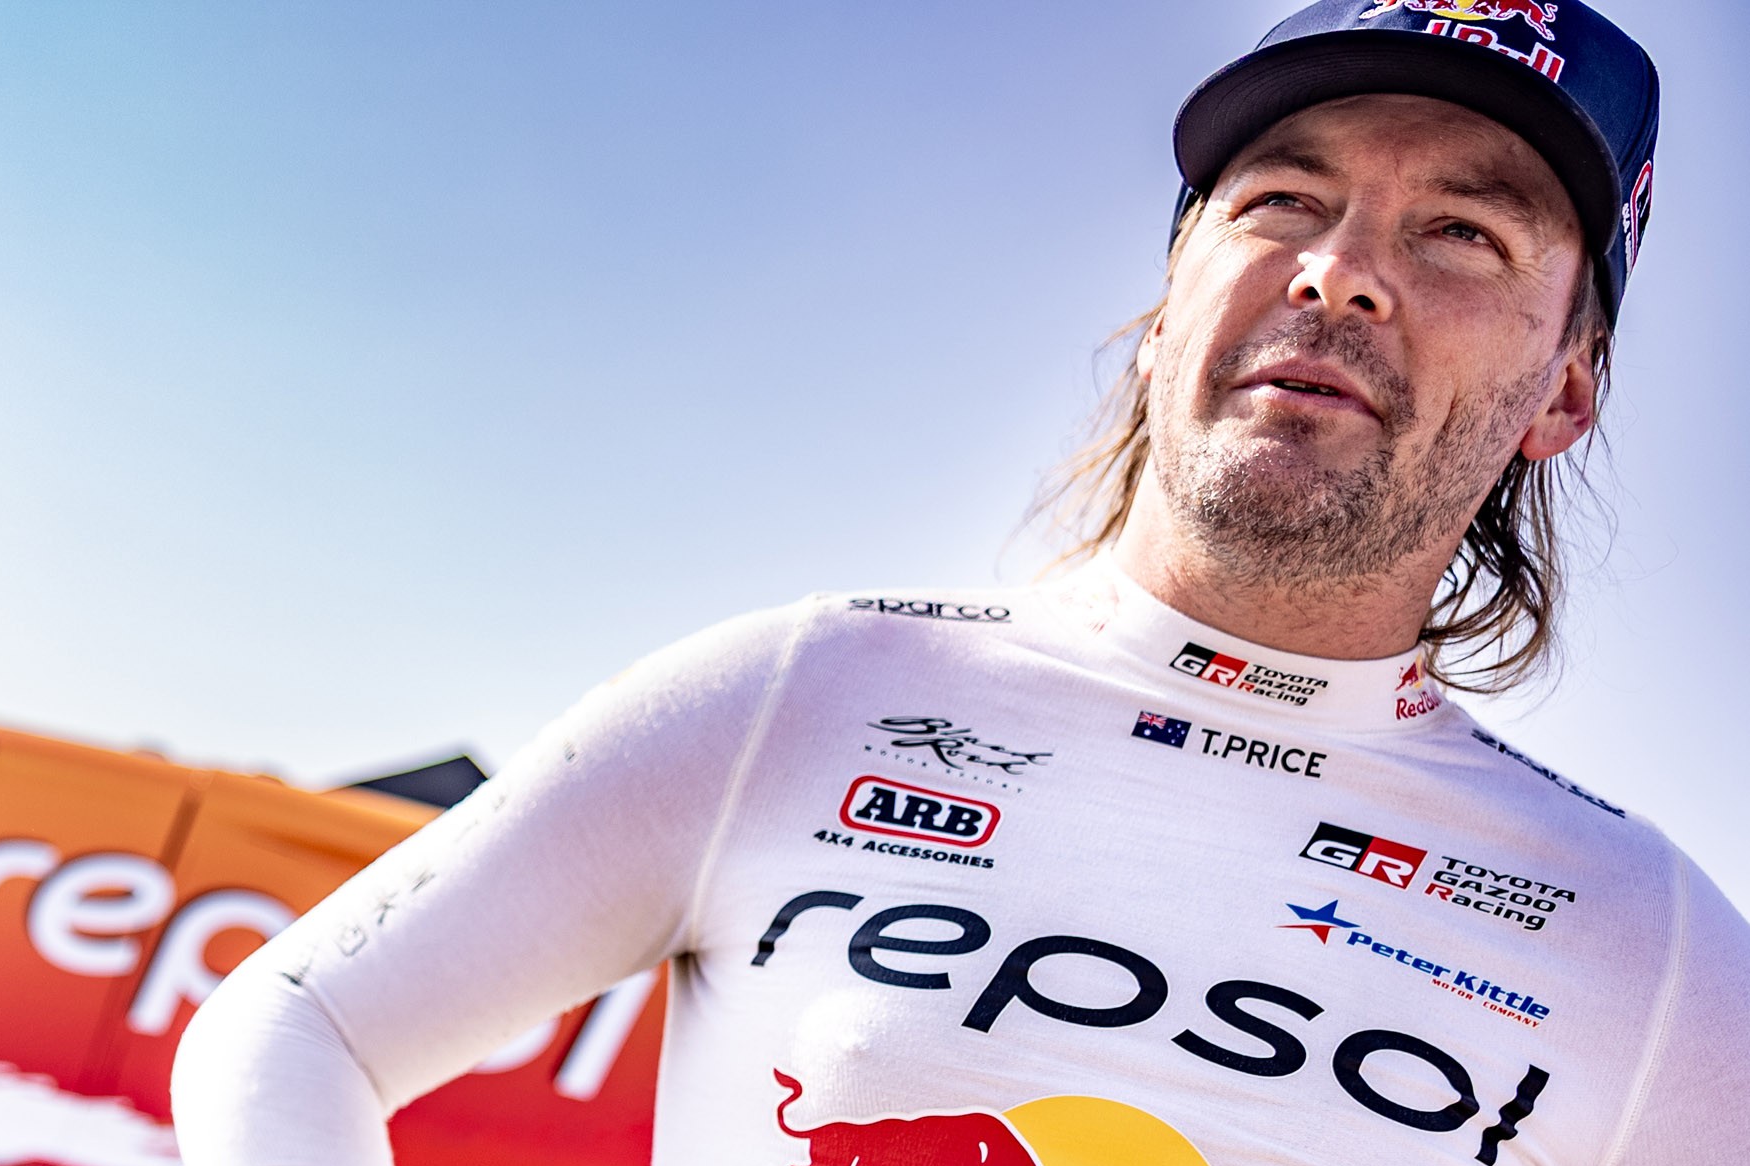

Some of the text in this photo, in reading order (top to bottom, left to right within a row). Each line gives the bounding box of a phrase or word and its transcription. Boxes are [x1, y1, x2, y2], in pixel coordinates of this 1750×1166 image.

[1172, 653, 1329, 689] GR TOYOTA
[1237, 682, 1308, 707] Racing
[1244, 674, 1316, 697] GAZOO
[1201, 728, 1328, 778] T.PRICE
[855, 786, 983, 838] ARB
[862, 840, 995, 869] ACCESSORIES
[1306, 839, 1576, 904] GR TOYOTA
[1424, 882, 1547, 931] Racing
[1433, 870, 1557, 913] GAZOO
[1346, 930, 1550, 1020] Peter Kittle
[751, 890, 1550, 1166] repsol
[1431, 978, 1540, 1029] MOTOR COMPANY
